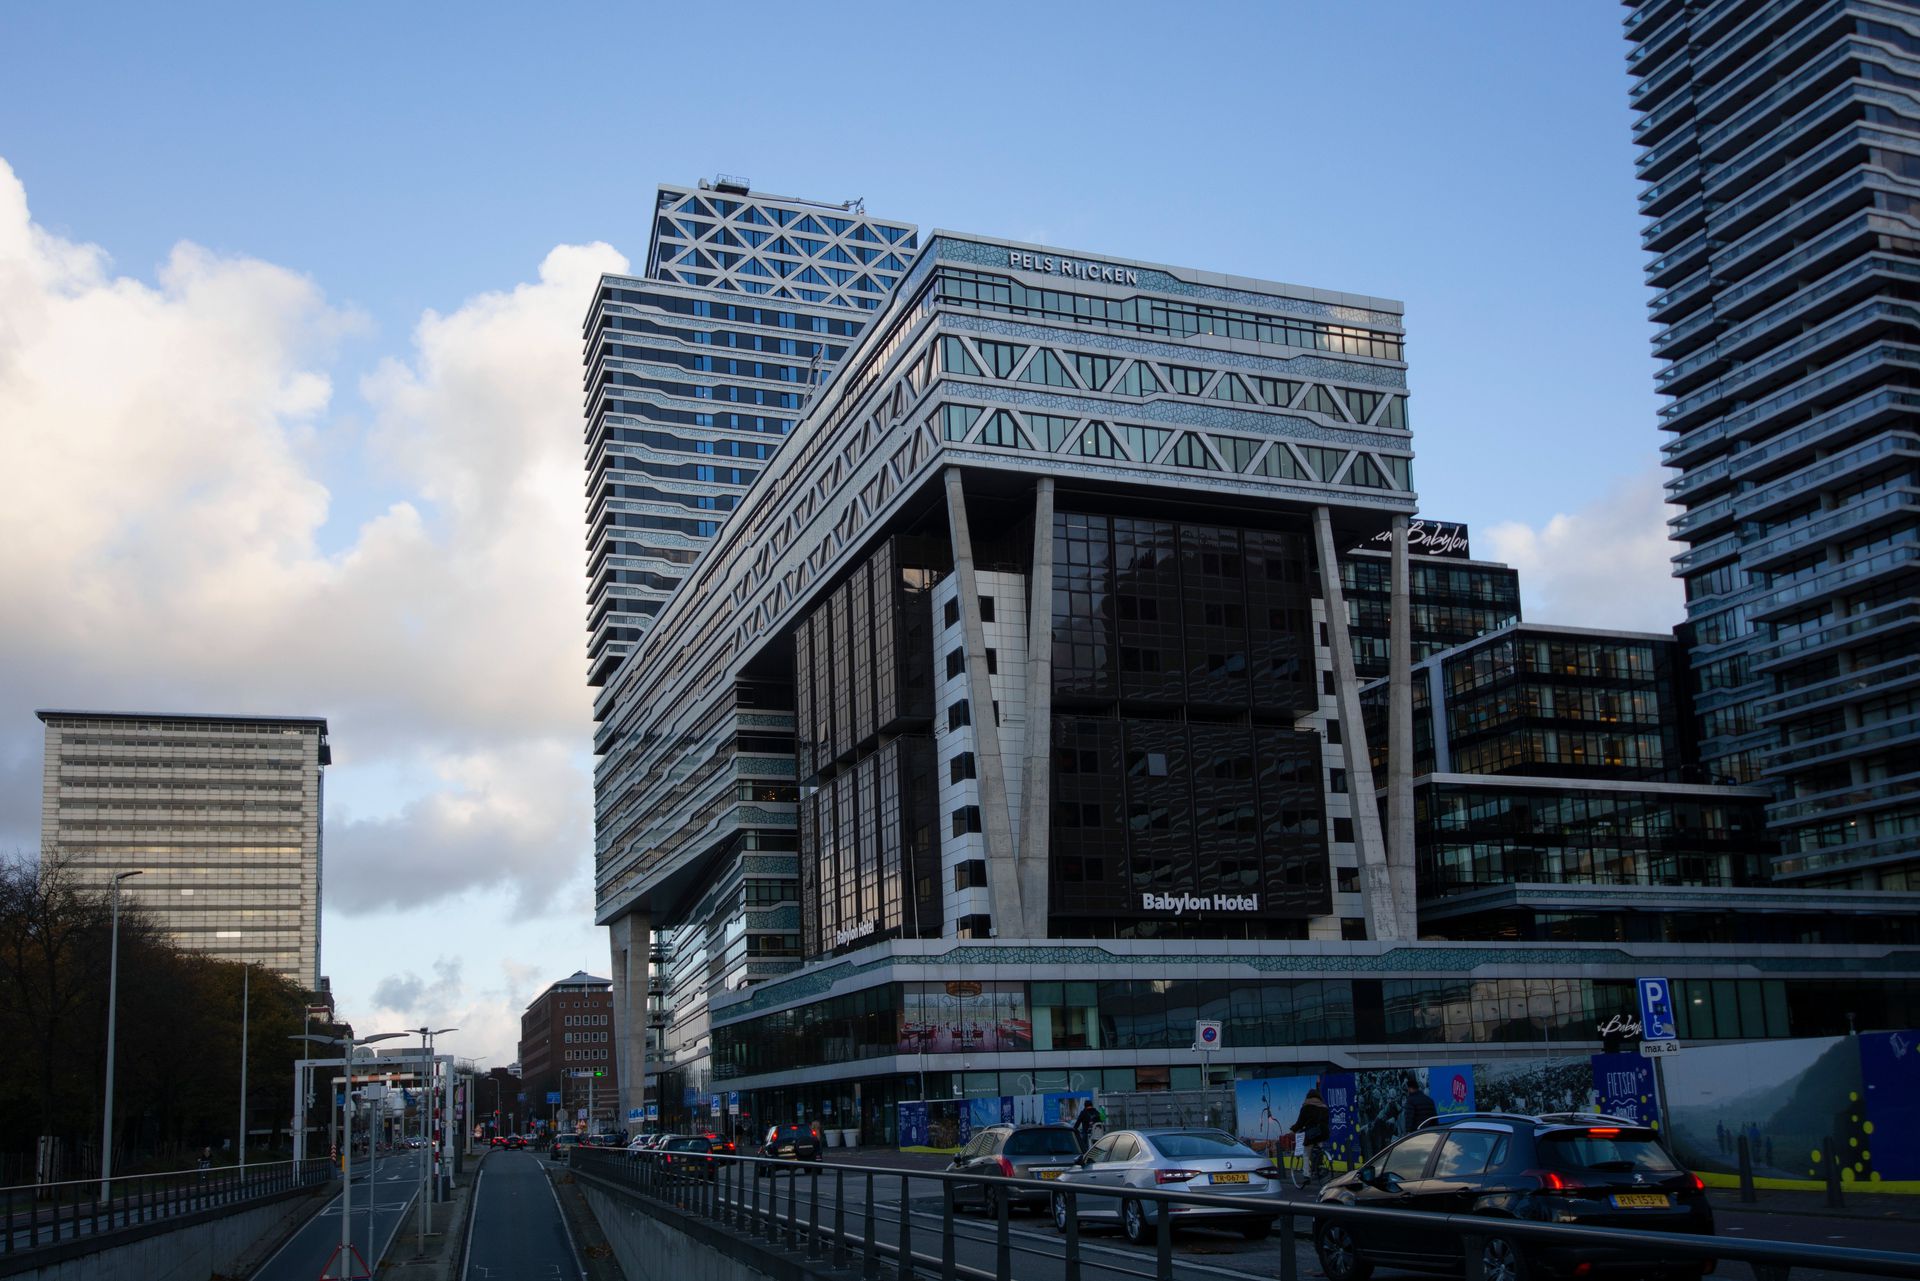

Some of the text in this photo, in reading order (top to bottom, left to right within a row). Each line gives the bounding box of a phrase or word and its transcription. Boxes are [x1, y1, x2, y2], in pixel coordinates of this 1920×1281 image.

[1010, 252, 1052, 272] PELS
[1143, 892, 1258, 915] Babylon Hotel
[1645, 982, 1663, 1013] P
[1645, 1042, 1677, 1053] max. 2u
[1607, 1071, 1637, 1098] FIETSEN
